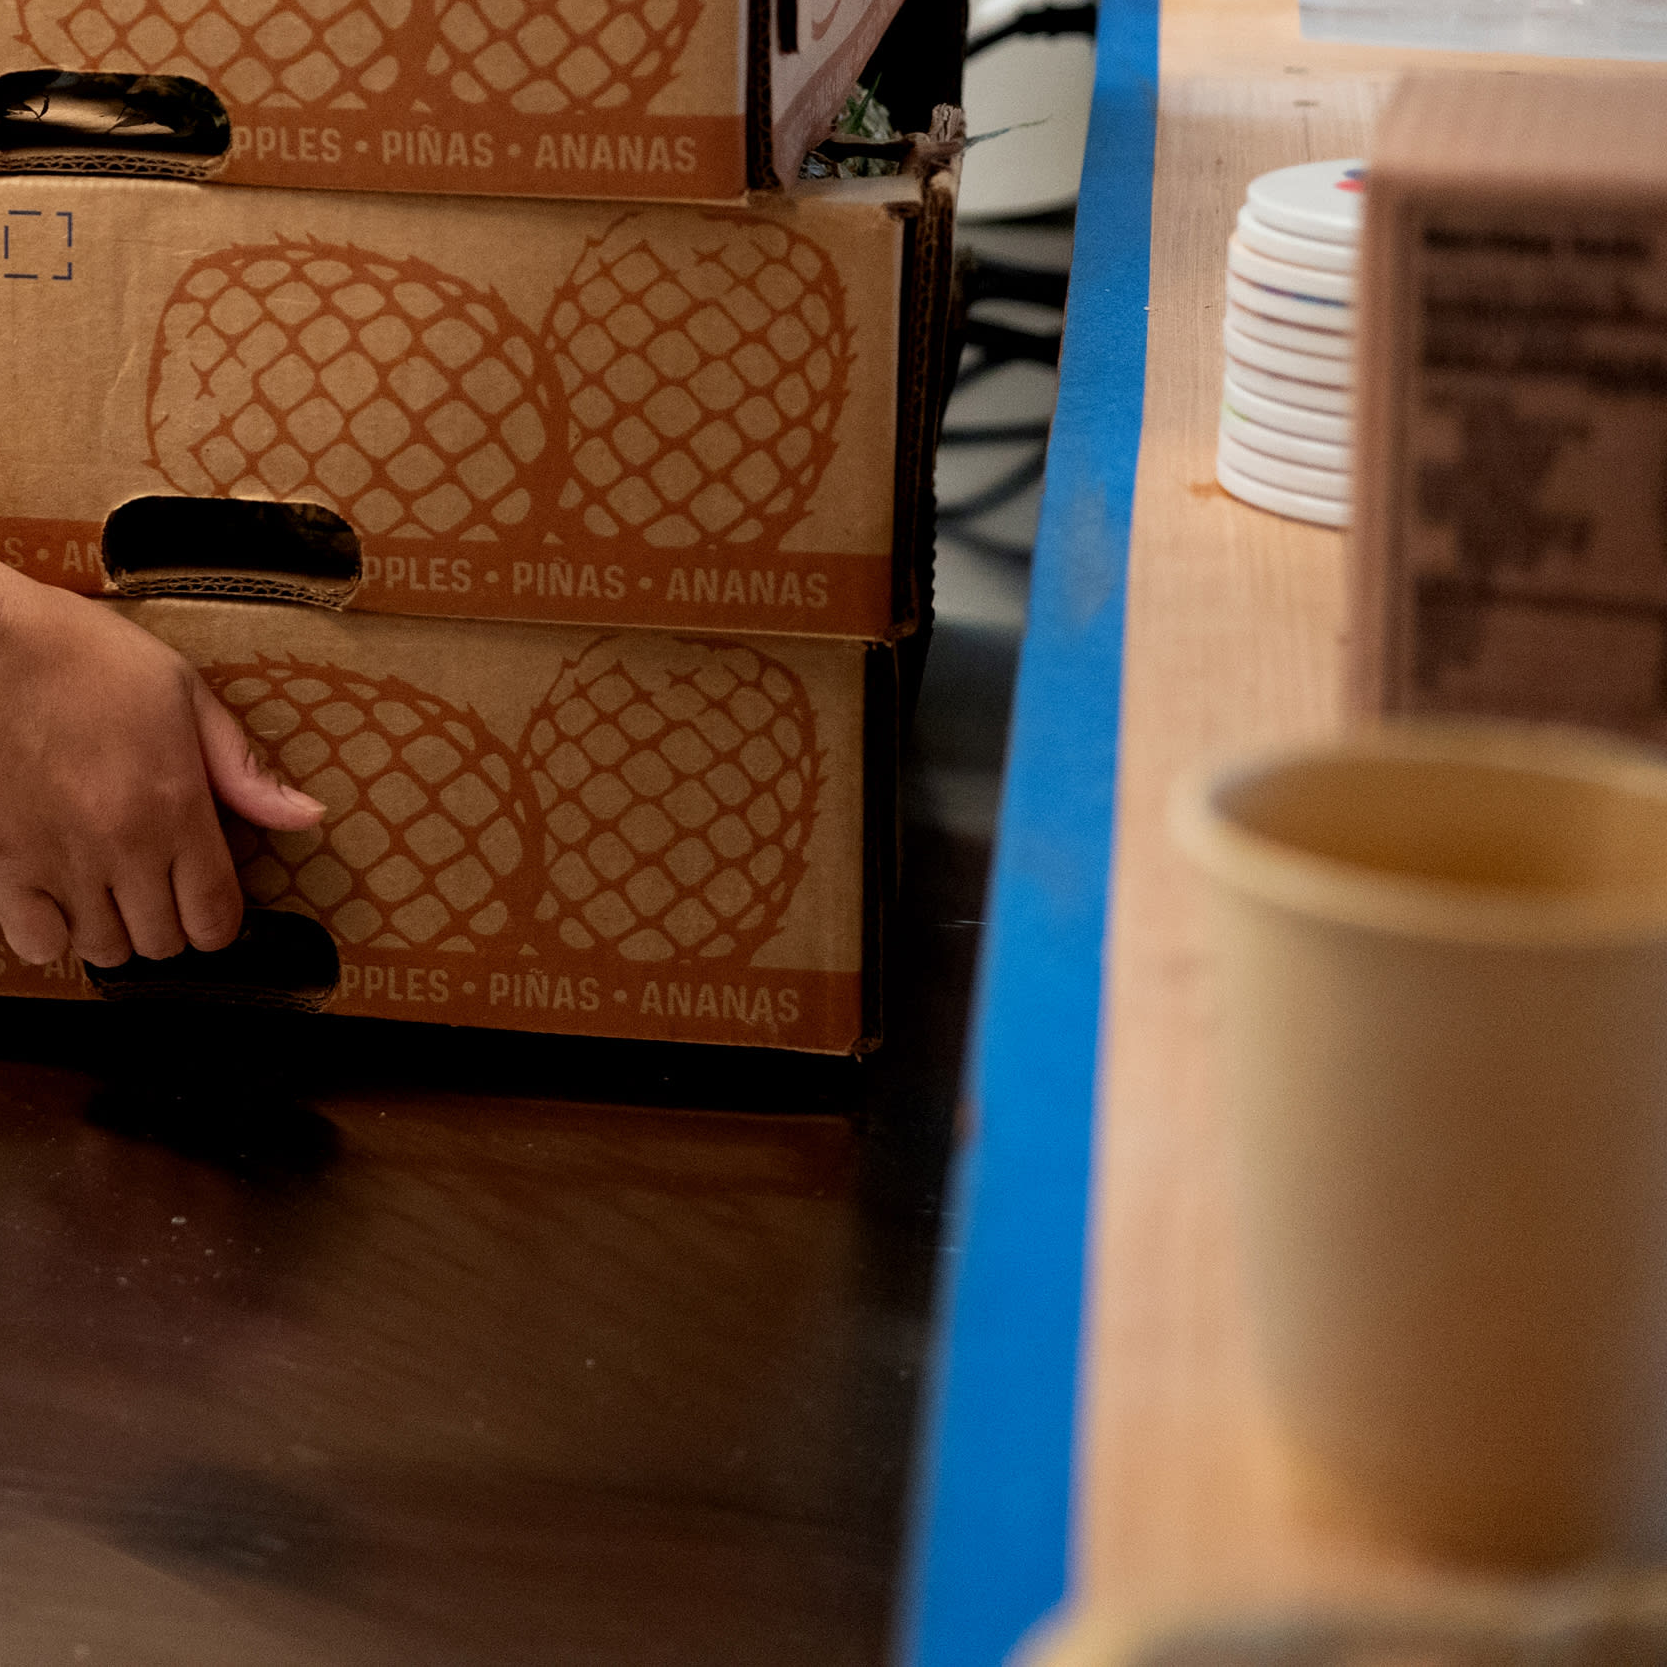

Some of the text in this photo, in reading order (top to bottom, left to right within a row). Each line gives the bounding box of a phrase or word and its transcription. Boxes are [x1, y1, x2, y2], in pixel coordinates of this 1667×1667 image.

[231, 124, 697, 173] PPLES PIÑAS ANANAS
[362, 555, 828, 609] PPLES PIÑAS ANANAS
[341, 964, 800, 1023] PPLES PIÑAS ANANAS
